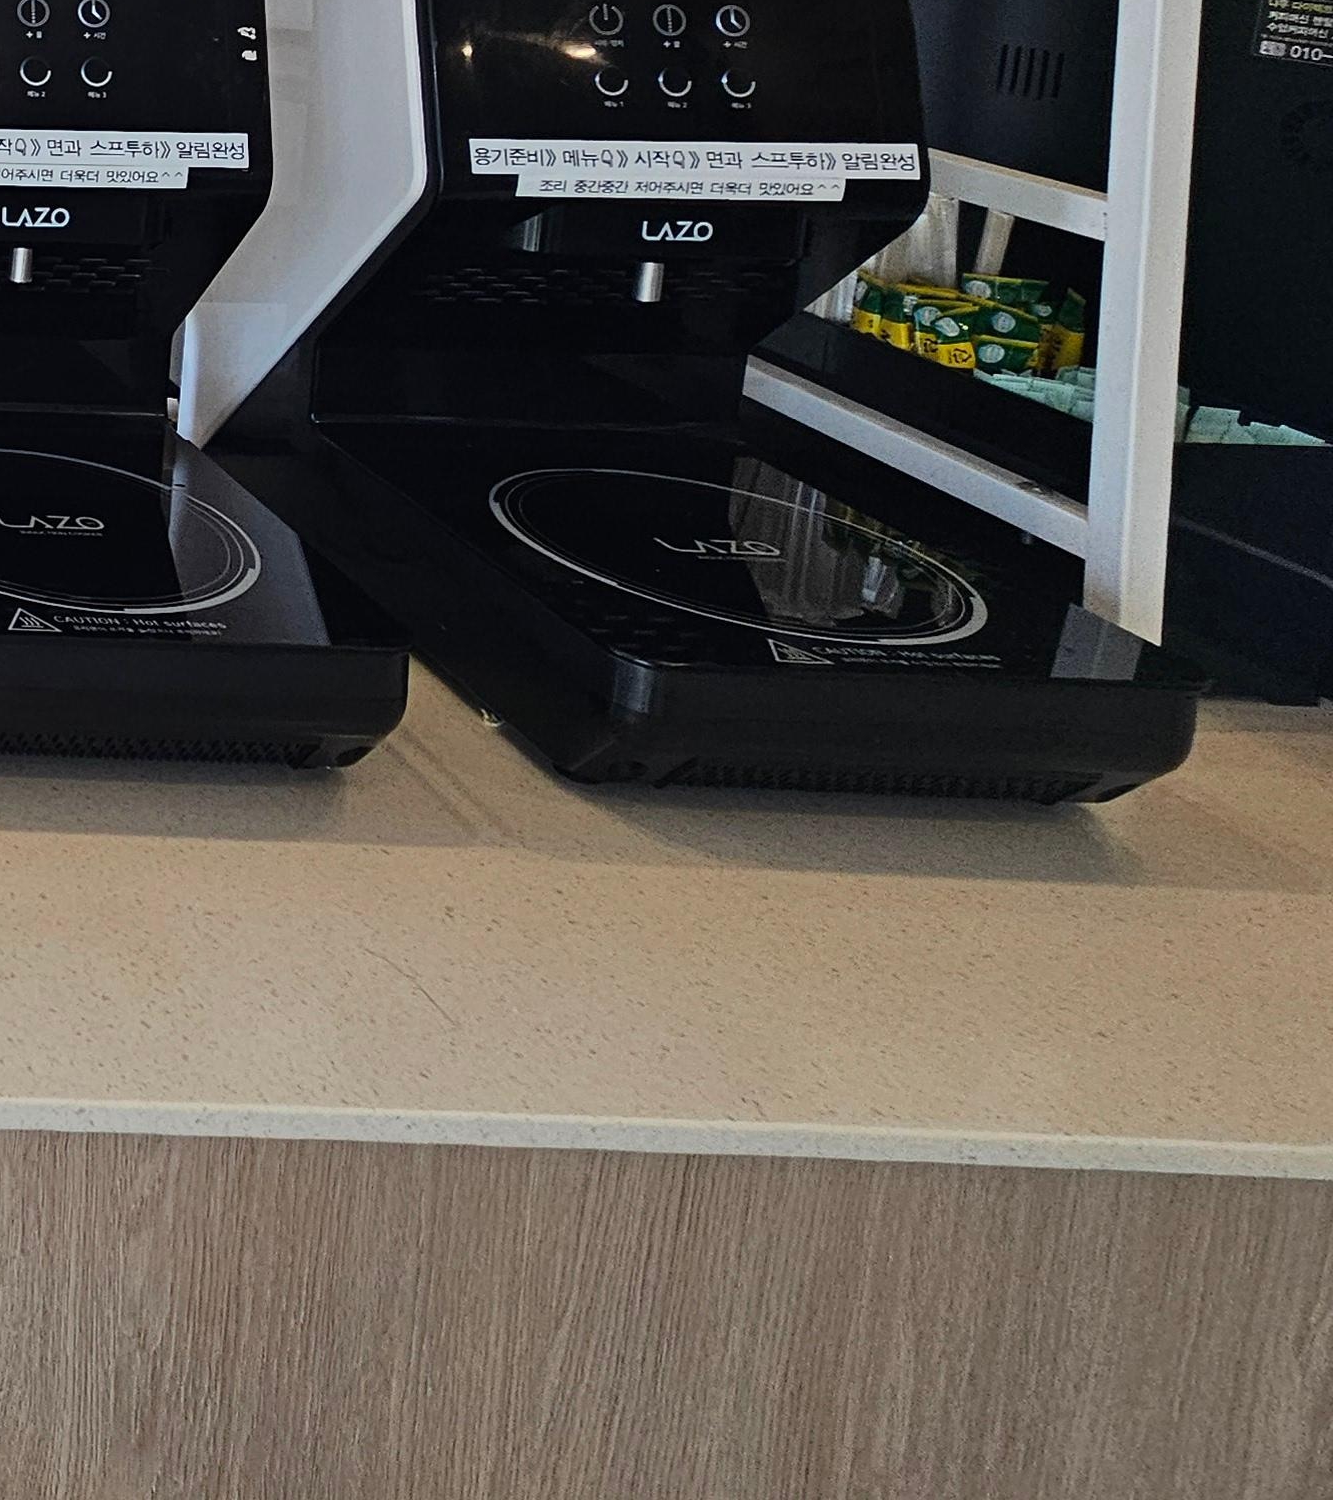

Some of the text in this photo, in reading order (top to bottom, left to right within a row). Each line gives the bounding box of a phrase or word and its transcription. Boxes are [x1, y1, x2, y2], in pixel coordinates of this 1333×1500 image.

[47, 139, 82, 157] 면과
[176, 141, 245, 160] 알림완성
[706, 151, 743, 169] 면과
[842, 153, 916, 171] 알림완성
[60, 170, 100, 183] 더욱더
[539, 179, 567, 192] 조리
[574, 180, 629, 194] 중간중간
[634, 181, 703, 195] 저어주시면
[710, 182, 752, 196] 더욱더
[1, 206, 70, 228] LAZO
[640, 220, 713, 242] LAZO
[653, 537, 781, 556] LAZO
[54, 615, 121, 625] CAUTION
